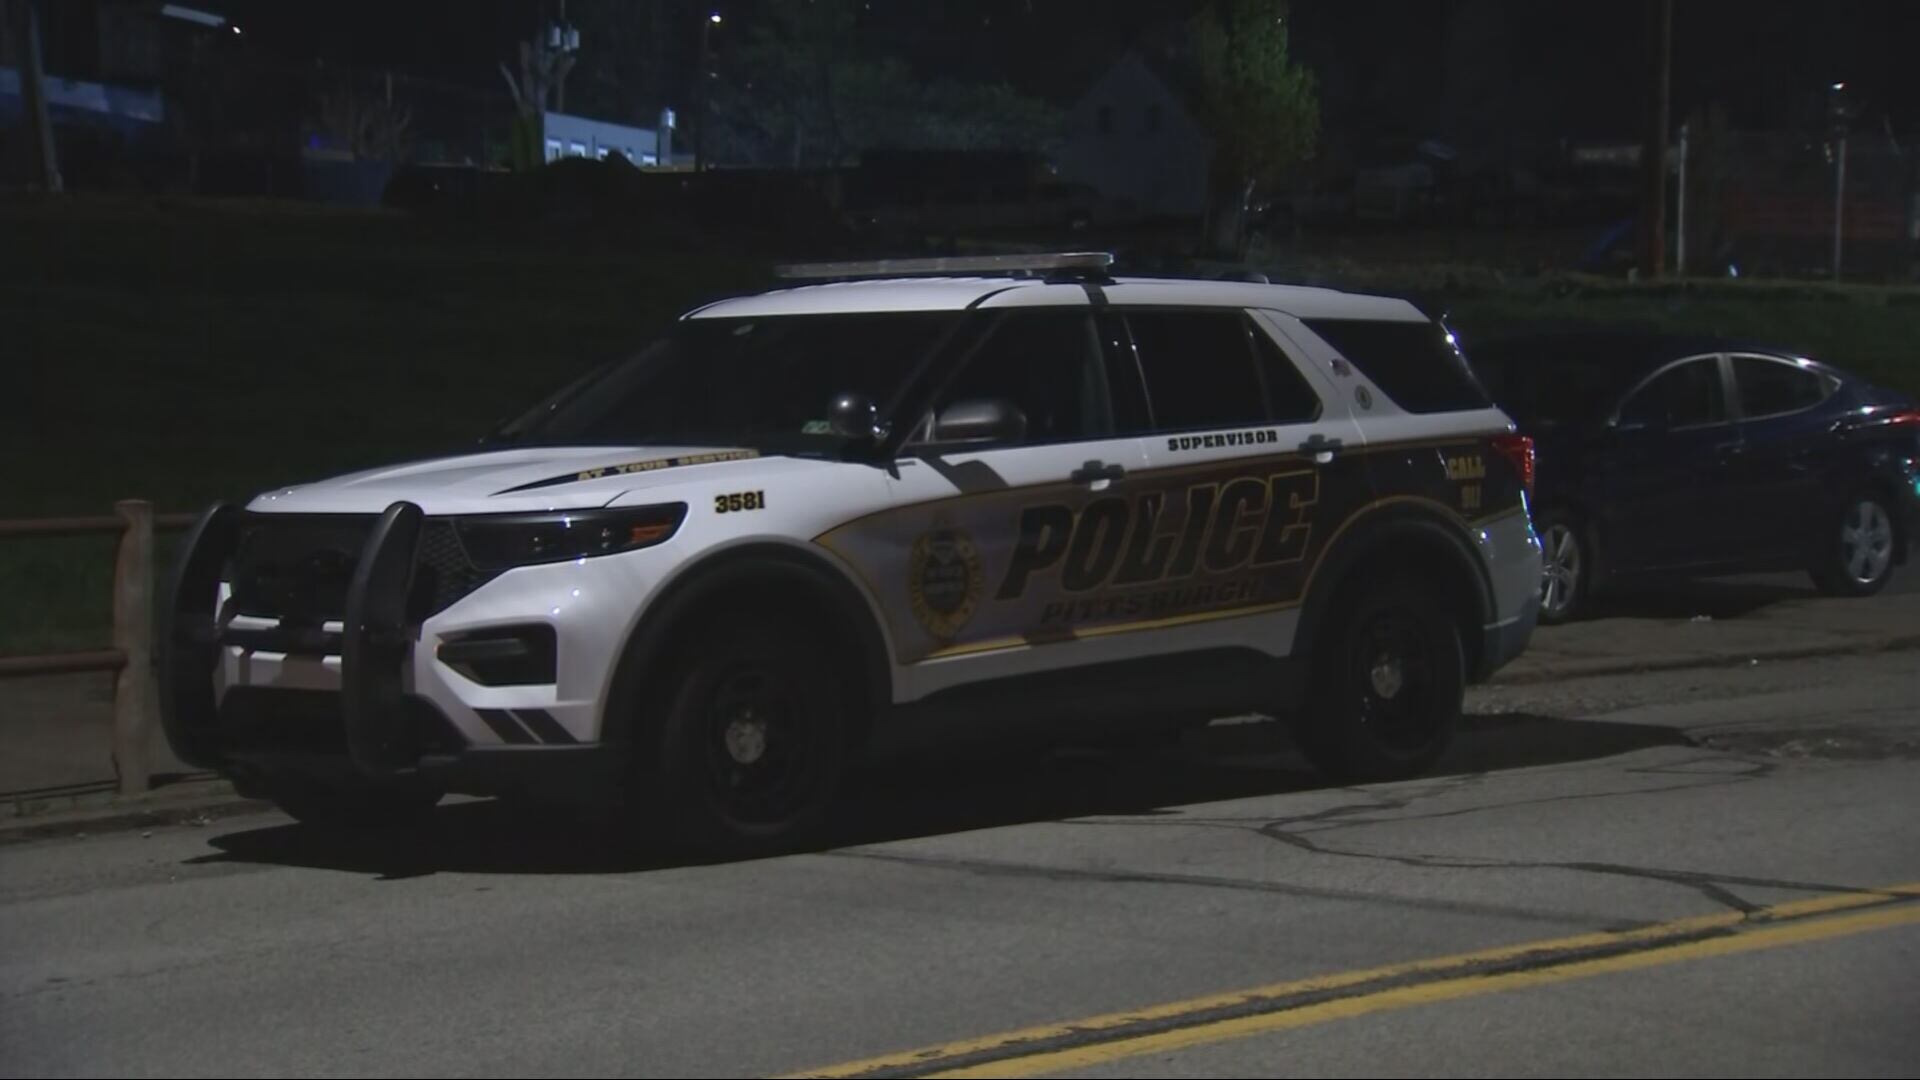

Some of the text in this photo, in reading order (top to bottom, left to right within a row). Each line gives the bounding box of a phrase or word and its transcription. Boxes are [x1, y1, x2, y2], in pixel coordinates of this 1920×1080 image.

[1168, 429, 1278, 451] SUPERVISOR
[577, 468, 606, 481] AT
[616, 459, 669, 475] YOUR
[1447, 455, 1486, 480] CALL
[715, 490, 764, 513] 3581
[997, 470, 1319, 600] POLICE
